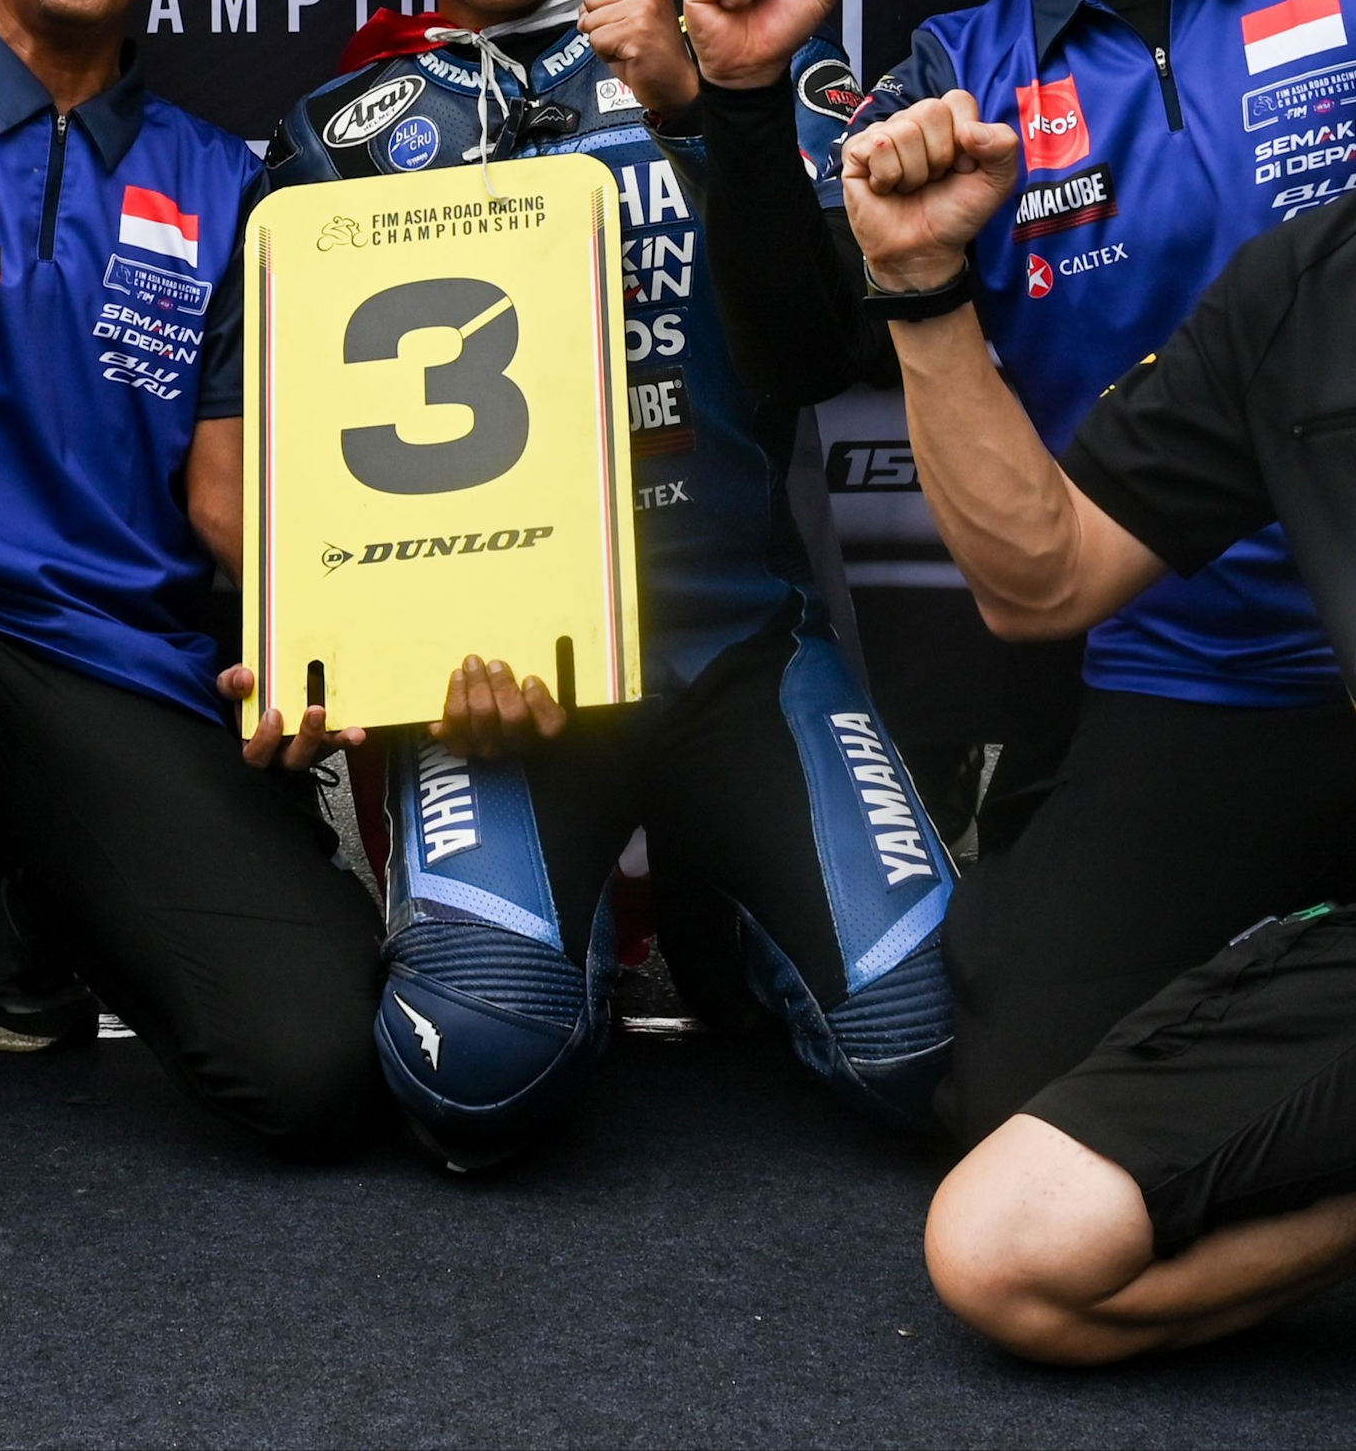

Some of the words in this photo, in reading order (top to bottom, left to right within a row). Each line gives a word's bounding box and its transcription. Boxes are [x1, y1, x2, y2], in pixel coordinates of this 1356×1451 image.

[1276, 87, 1291, 99] FIM
[1291, 82, 1308, 96] ASIA
[1308, 76, 1330, 90] ROAD
[336, 80, 409, 143] Arai
[362, 107, 397, 133] HELMET
[1284, 105, 1308, 119] FIM
[409, 129, 433, 151] CRU
[372, 212, 399, 229] FIM
[404, 207, 438, 225] ASIA
[443, 202, 482, 221] ROAD
[489, 195, 544, 215] RACING
[372, 212, 546, 246] CHAMPIONSHIP
[1059, 242, 1129, 276] CALTEX
[134, 277, 201, 304] CHAMPIONSHIP
[147, 272, 162, 284] ASIA
[122, 328, 198, 365] DEPAN
[98, 351, 180, 383] BLU
[102, 367, 182, 400] CRU
[341, 277, 529, 495] 3
[357, 526, 554, 565] DUNLOP
[830, 711, 935, 892] YAMAHA
